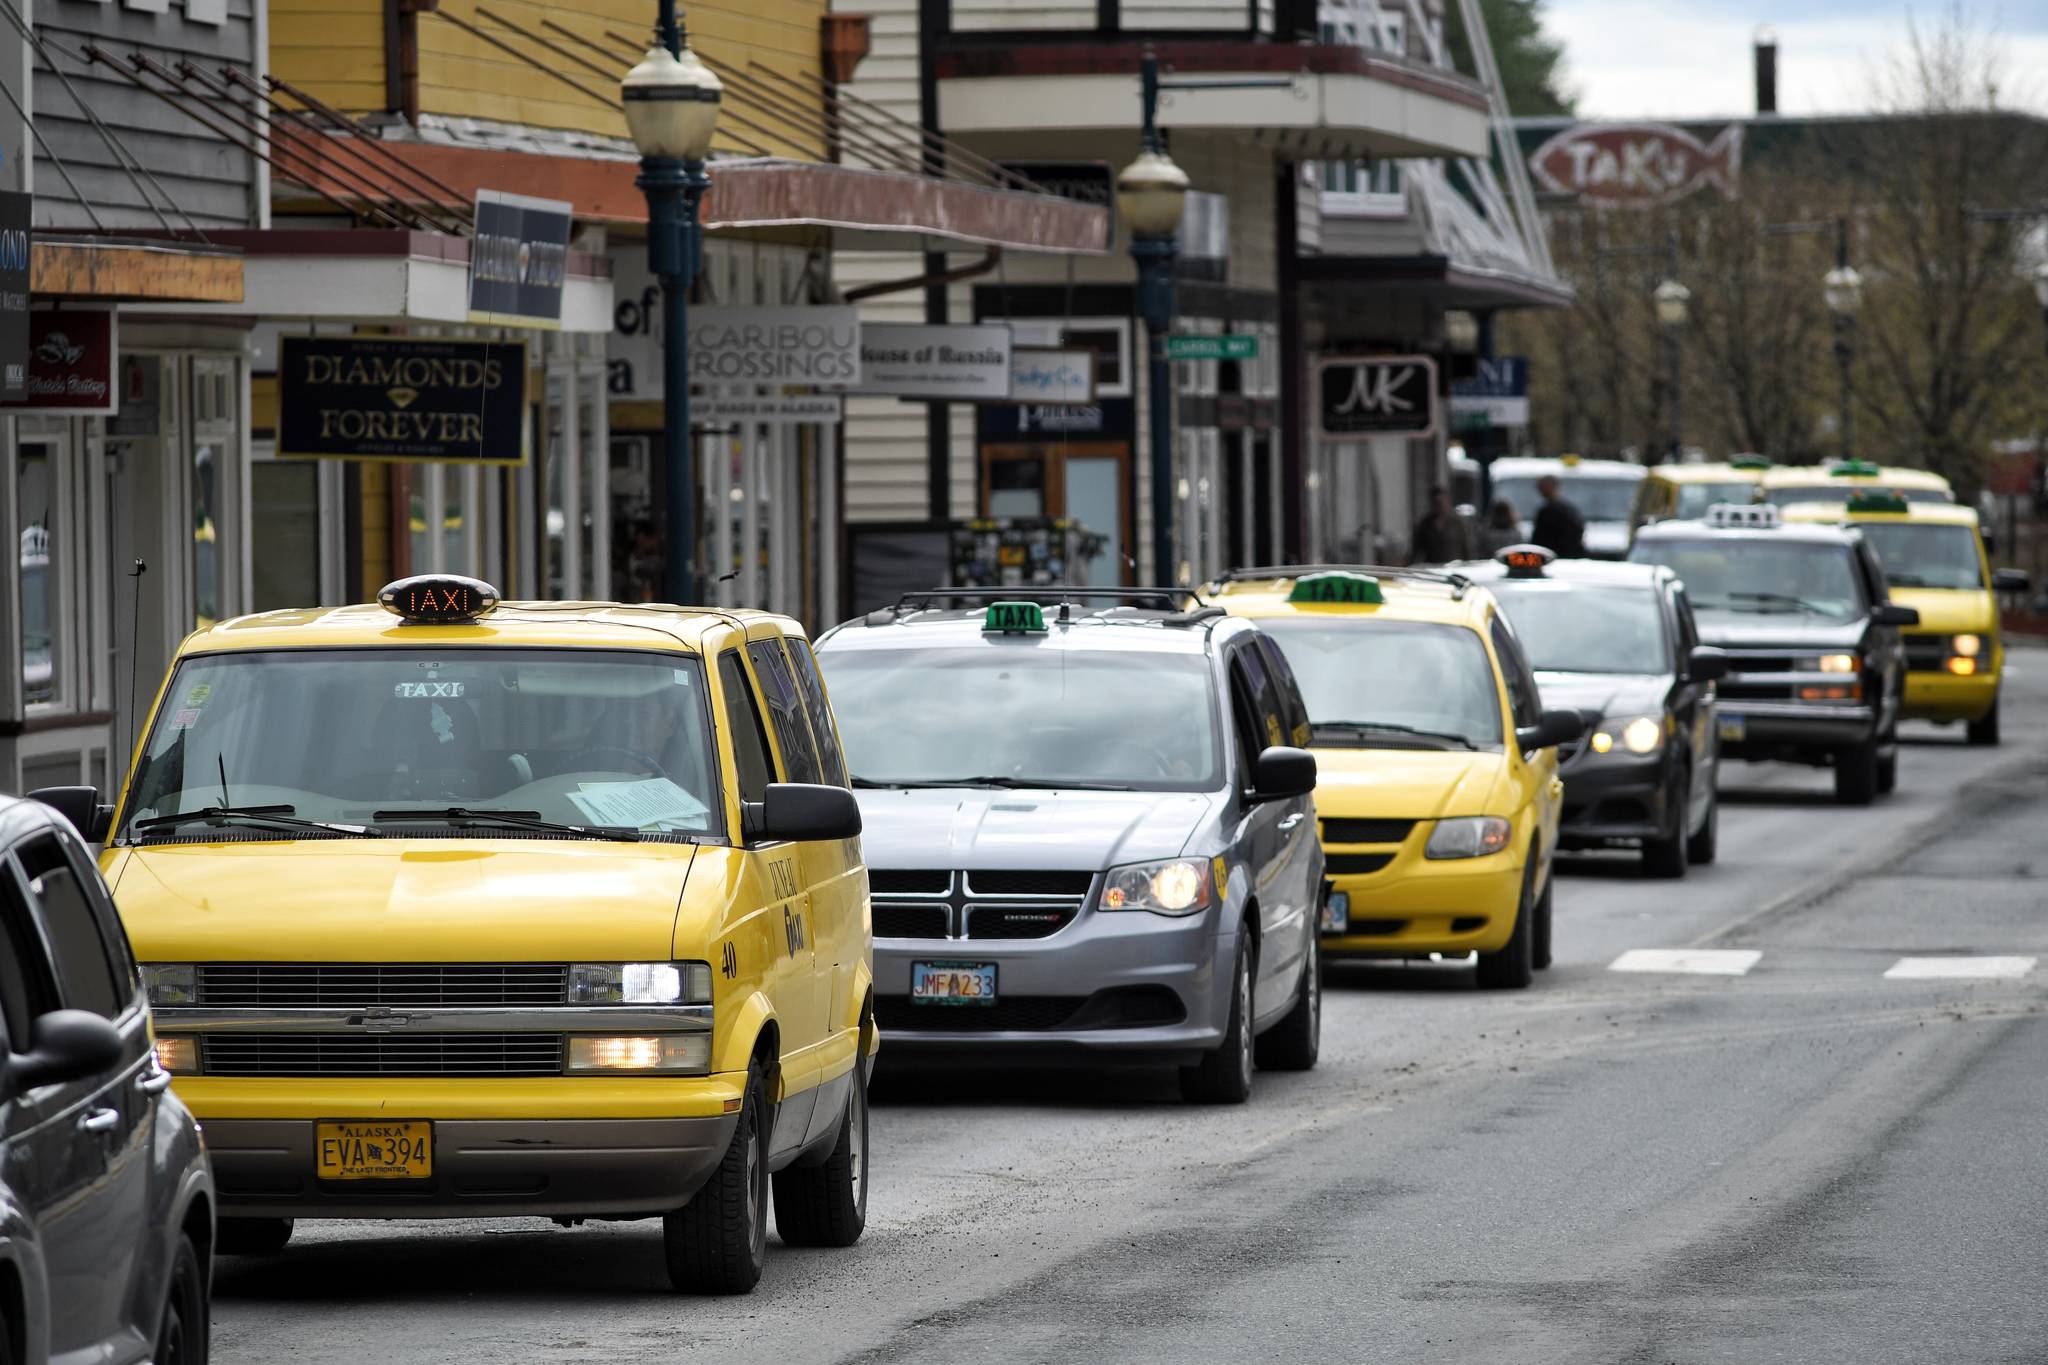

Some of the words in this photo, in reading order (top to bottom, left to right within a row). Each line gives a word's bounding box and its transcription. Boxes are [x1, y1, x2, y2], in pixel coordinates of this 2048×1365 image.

[696, 323, 856, 350] CARIBOU
[938, 346, 1005, 365] Russia
[304, 354, 503, 389] DIAMONDS
[320, 409, 483, 442] FOREVER
[1308, 580, 1364, 602] TAXI
[993, 606, 1034, 627] TAXI
[401, 682, 461, 697] TAXI
[722, 941, 737, 979] 40
[914, 973, 946, 996] JMF
[961, 974, 994, 997] 233
[345, 1128, 403, 1137] ALASKA
[323, 1138, 365, 1166] EVA
[384, 1137, 427, 1166] 394
